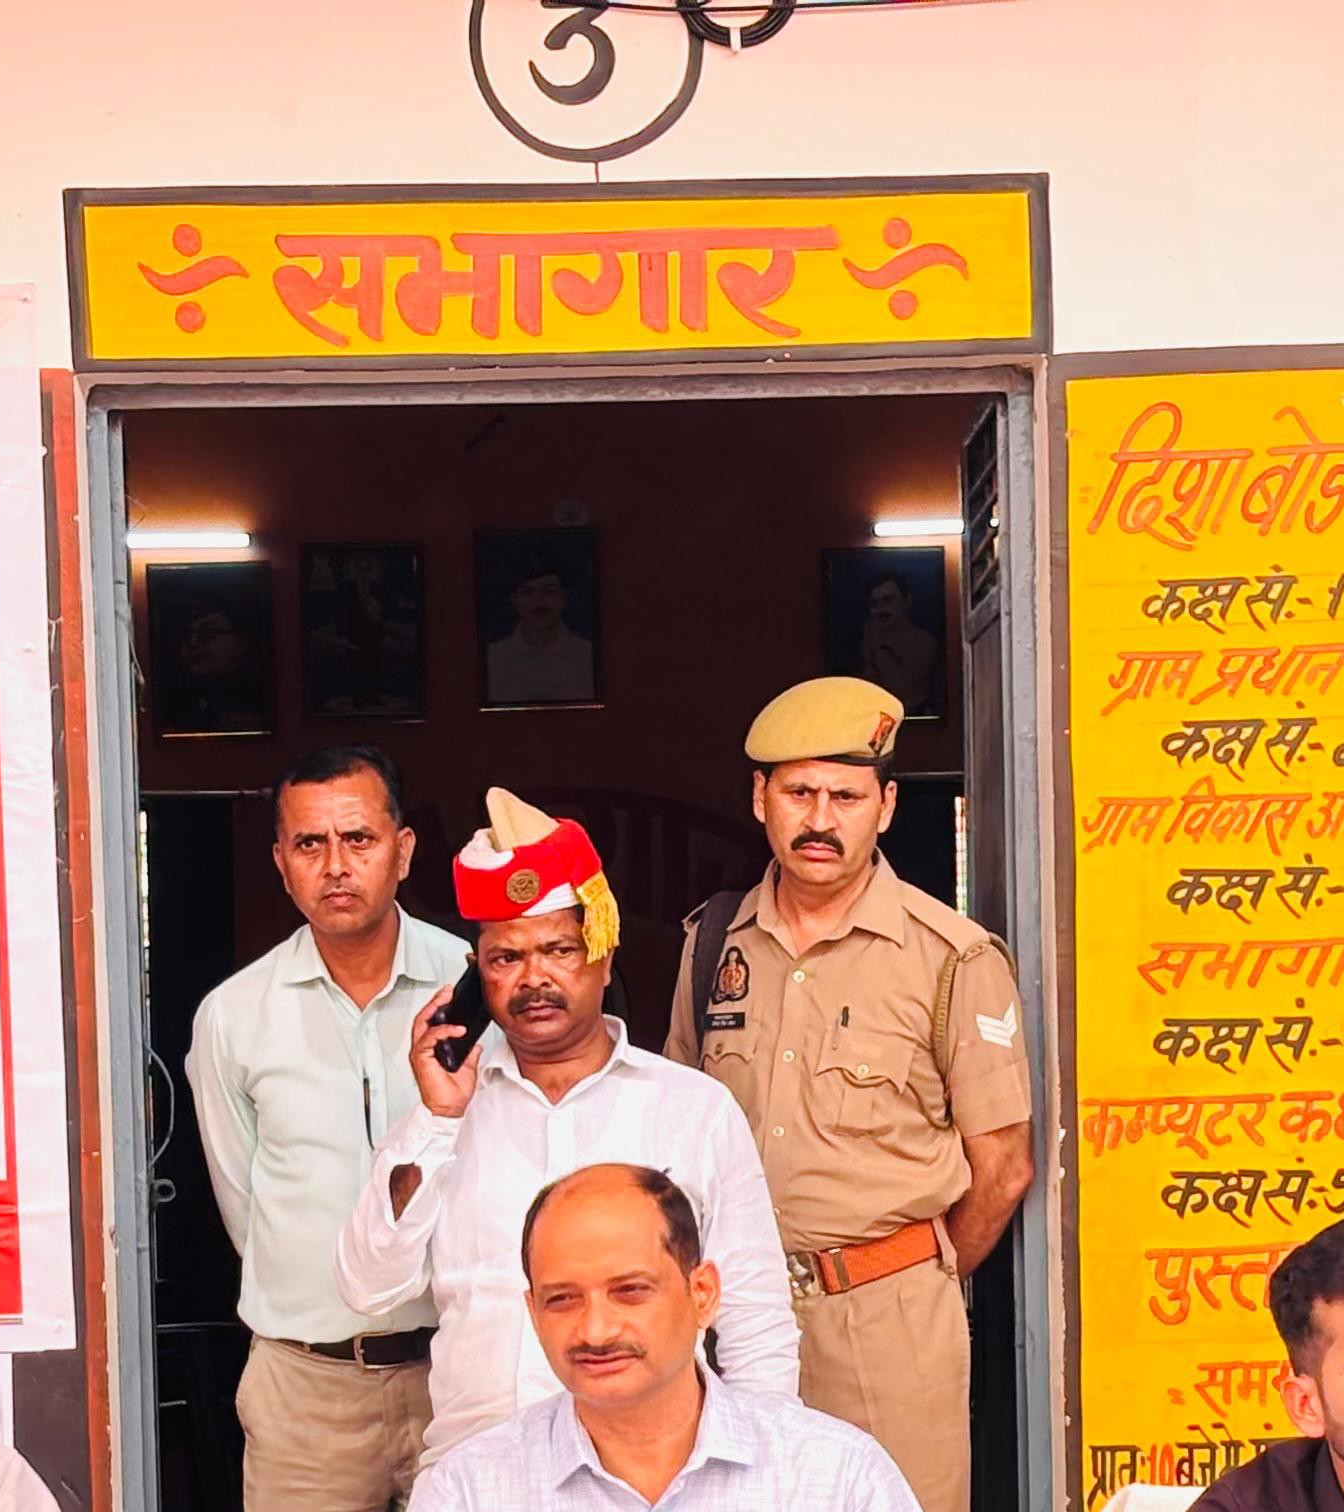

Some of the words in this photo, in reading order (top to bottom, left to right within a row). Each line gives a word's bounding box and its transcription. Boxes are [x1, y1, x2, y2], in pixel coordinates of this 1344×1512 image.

[272, 225, 840, 347] सभागार
[1086, 400, 1254, 552] दिशा
[1141, 574, 1251, 635] कक्ष
[1100, 650, 1205, 717] ग्राम
[1160, 717, 1268, 783] कक्ष
[1081, 796, 1175, 854] ग्राम
[1163, 774, 1313, 857] विकास
[1166, 868, 1275, 926] कक्ष
[1151, 1017, 1263, 1075] कक्ष
[1161, 1168, 1267, 1229] कक्ष
